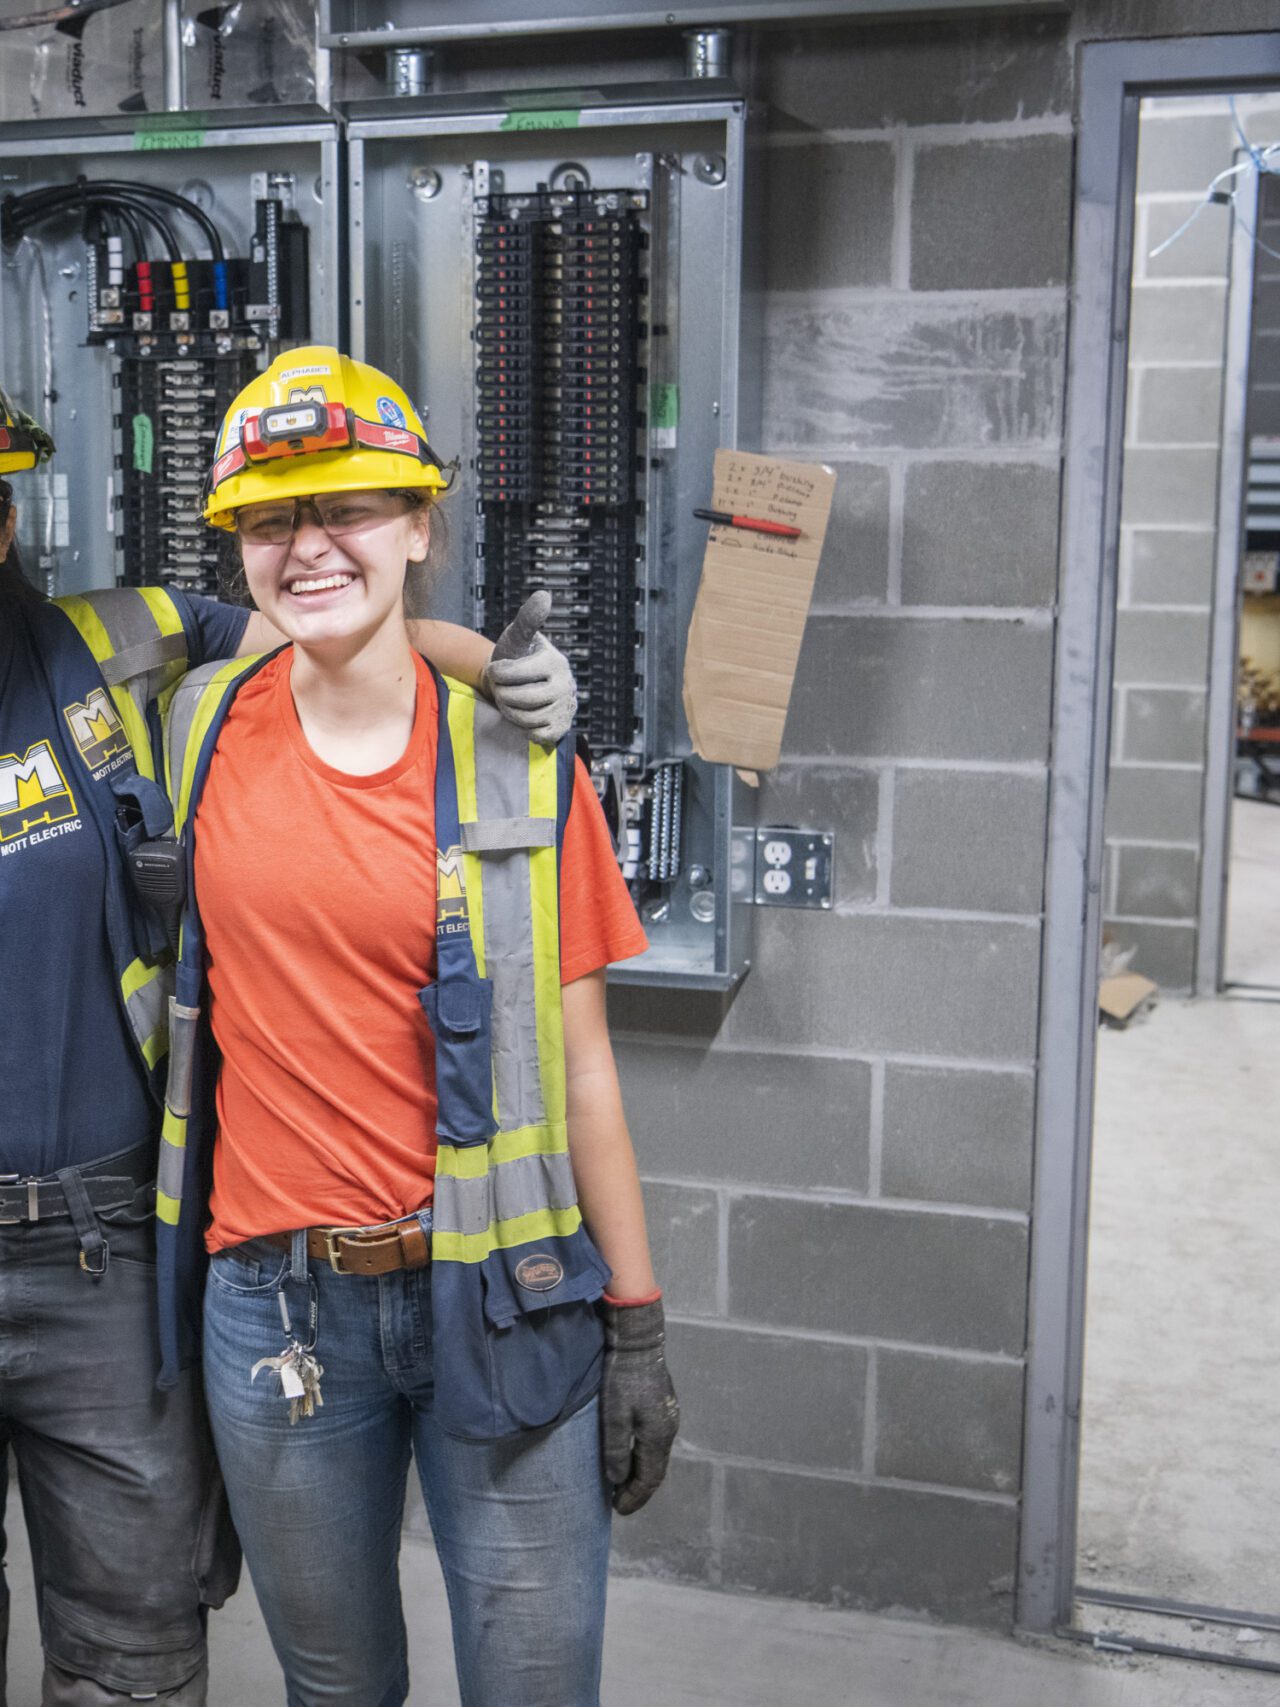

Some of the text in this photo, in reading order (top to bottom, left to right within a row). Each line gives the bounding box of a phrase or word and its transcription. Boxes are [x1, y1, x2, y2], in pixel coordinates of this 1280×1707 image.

[72, 43, 86, 107] viaduct
[211, 34, 226, 100] viaduct
[92, 750, 134, 782] MOTT ELECTRIC
[1, 818, 83, 857] MOTT ELECTRIC
